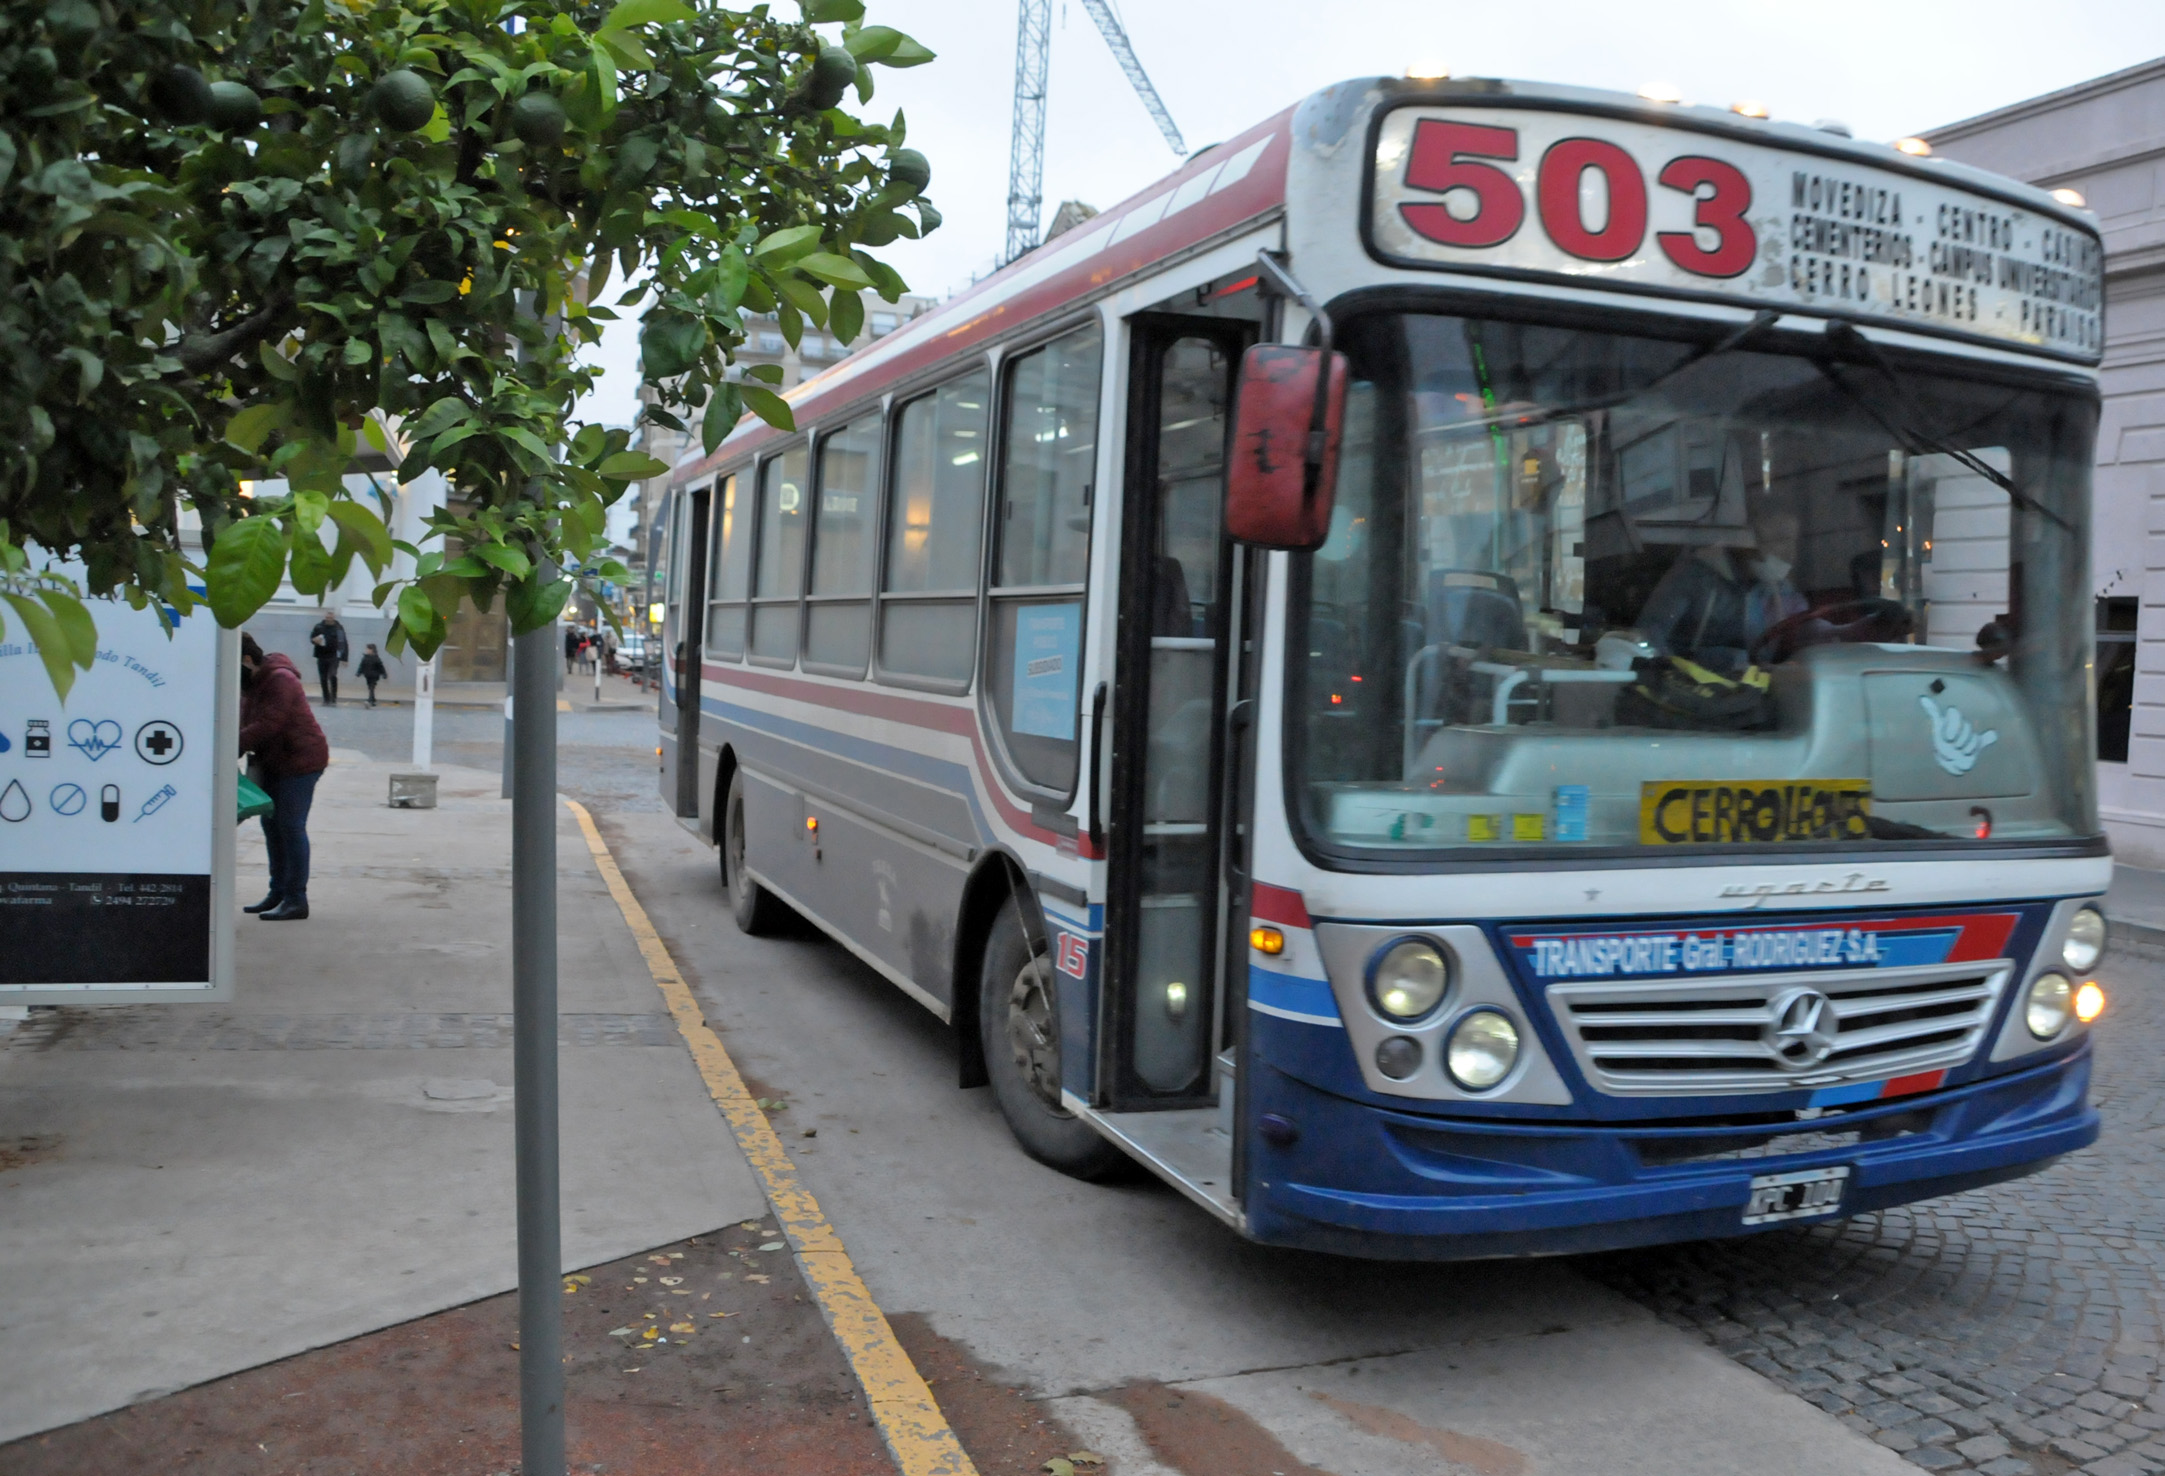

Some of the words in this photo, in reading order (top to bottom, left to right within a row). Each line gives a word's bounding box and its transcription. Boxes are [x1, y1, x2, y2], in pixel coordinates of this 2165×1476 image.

[1398, 118, 1757, 279] 503
[1791, 171, 1903, 228] MOVEDIZA
[1937, 203, 2013, 252] CENTRO
[1790, 254, 1870, 302] CERRO
[1892, 271, 1978, 322] LEONES
[1928, 240, 1993, 286] CAMPUS
[95, 649, 119, 664] odo
[123, 655, 166, 689] Tandil
[1056, 930, 1090, 981] 15
[1532, 934, 1678, 977] TRANSPORTE
[1732, 929, 1845, 968] RODRIGUEZ
